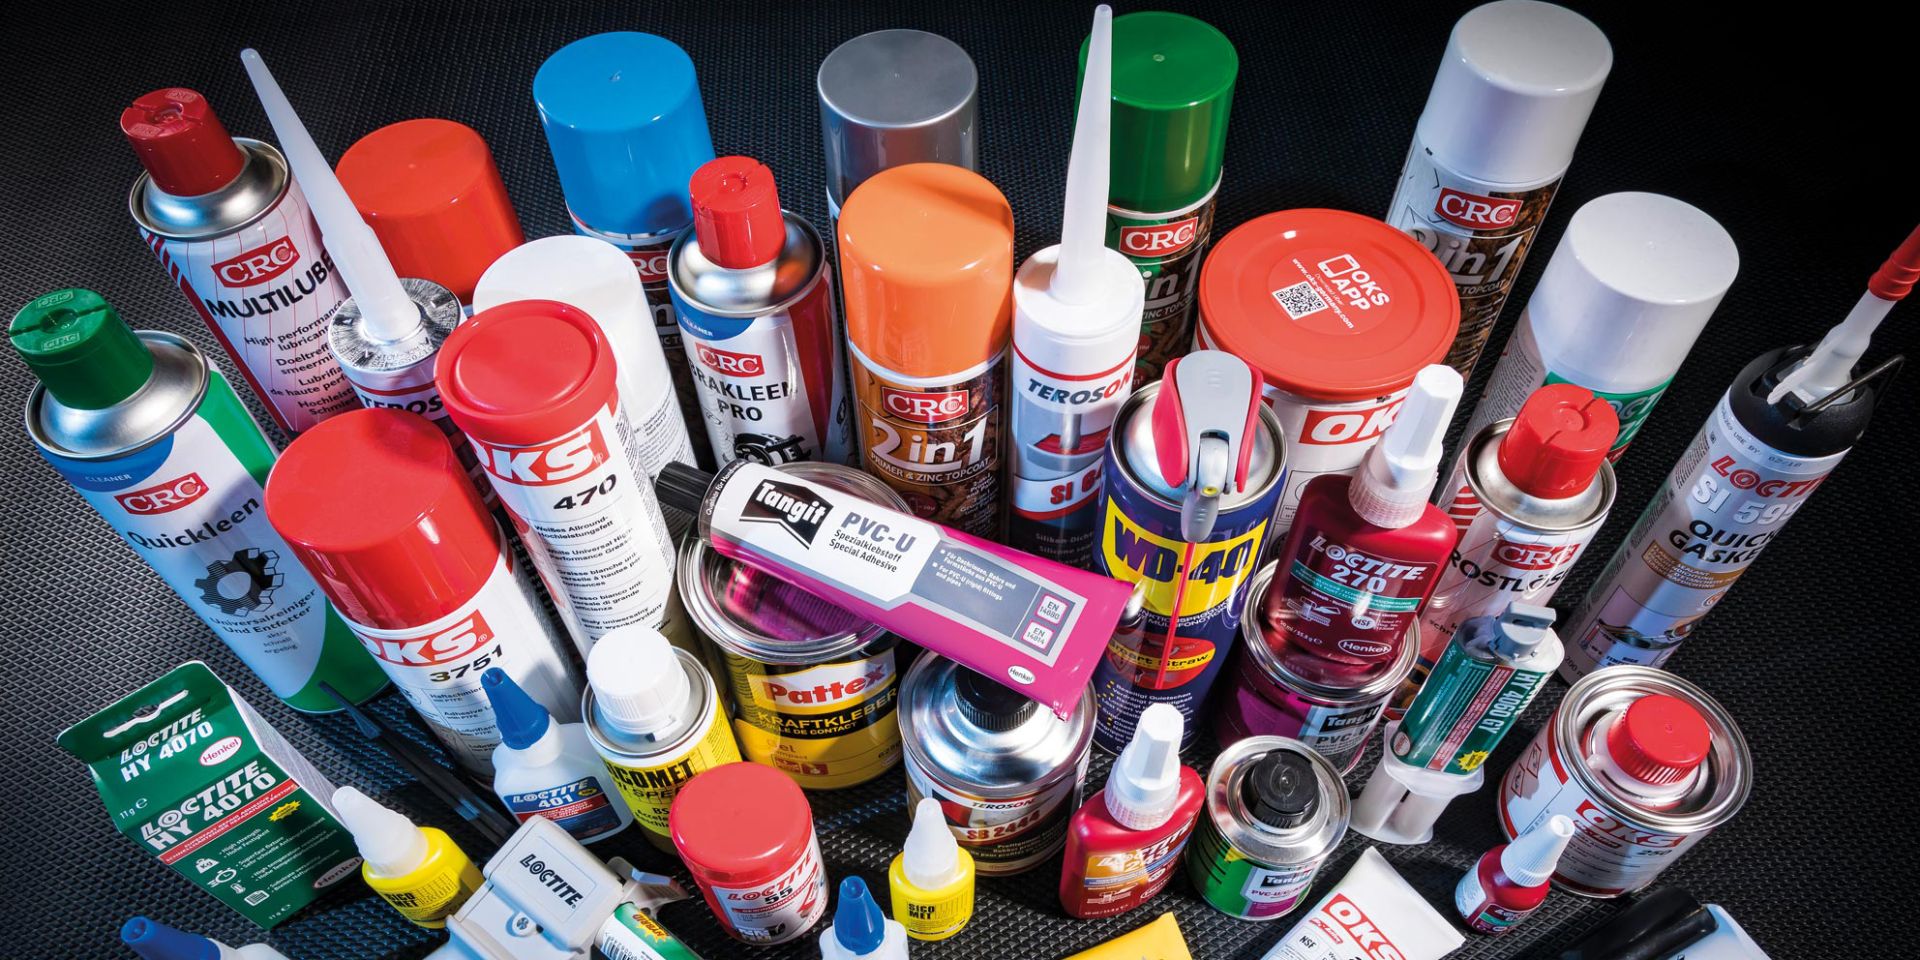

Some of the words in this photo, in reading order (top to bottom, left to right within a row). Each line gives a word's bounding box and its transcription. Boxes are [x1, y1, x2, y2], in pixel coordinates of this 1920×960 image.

[1441, 194, 1515, 224] CRC
[1126, 222, 1193, 251] CRC
[220, 240, 294, 283] CRC
[205, 250, 334, 319] MULTILUBE
[1292, 258, 1354, 329] www.oks-germany.com
[1331, 278, 1371, 310] APP
[1351, 270, 1390, 306] OKS
[244, 335, 274, 347] High
[277, 300, 343, 344] performance
[1143, 309, 1162, 319] INC
[699, 348, 760, 374] CRC
[286, 384, 321, 397] haute
[1029, 366, 1133, 405] TEROSON
[718, 397, 763, 422] PRO
[887, 393, 964, 418] CRC
[85, 473, 131, 483] CLEANER
[871, 453, 903, 480] PRIMER
[905, 471, 914, 480] &
[916, 472, 943, 482] ZINC
[945, 455, 990, 480] TOPCOAT
[124, 477, 201, 512] CRC
[553, 474, 617, 510] 470
[756, 481, 826, 524] Tangit
[1050, 482, 1073, 505] SI
[1691, 474, 1731, 514] SI
[127, 497, 260, 550] Quickleen
[841, 512, 917, 553] PVC-U
[829, 538, 860, 557] Special
[859, 554, 897, 573] Adhesive
[834, 529, 902, 563] Spezialklebstoff
[1114, 515, 1255, 585] WD-40
[1309, 536, 1427, 580] LOCTITE
[1498, 544, 1574, 566] CRC
[1330, 565, 1387, 593] 270
[209, 589, 316, 627] Universalreiniger
[222, 626, 251, 635] Und
[253, 606, 312, 634] Entfetter
[1047, 601, 1059, 612] EN
[1033, 627, 1045, 637] EN
[1343, 640, 1388, 653] Henkel
[430, 644, 503, 682] 3751
[1009, 667, 1033, 682] Henkel
[761, 664, 885, 704] Pattex
[1511, 672, 1536, 691] HY
[758, 686, 897, 729] KRAFTKLEBER
[1489, 690, 1524, 718] 4060
[121, 708, 203, 764] LOCTITE
[809, 722, 857, 736] CONTACT
[1478, 718, 1505, 734] GY
[121, 755, 153, 782] HY
[158, 721, 214, 758] 4070
[202, 739, 239, 764] Henkel
[140, 760, 262, 841] LOCTITE
[512, 779, 588, 803] LOCTITE
[538, 793, 574, 808] 401
[971, 798, 1035, 809] TEROSON
[145, 817, 194, 851] HY
[203, 771, 277, 822] 4070
[966, 828, 990, 841] SB
[993, 810, 1041, 838] 2444
[221, 842, 237, 853] High
[236, 829, 261, 845] strength
[242, 829, 269, 846] Festigkeit
[1583, 808, 1675, 847] OKS
[519, 852, 584, 906] LOCTITE
[728, 847, 812, 901] LOCTITE
[764, 885, 793, 905] 55
[908, 903, 935, 913] SICO
[909, 910, 931, 920] MET
[1299, 935, 1317, 949] NSF
